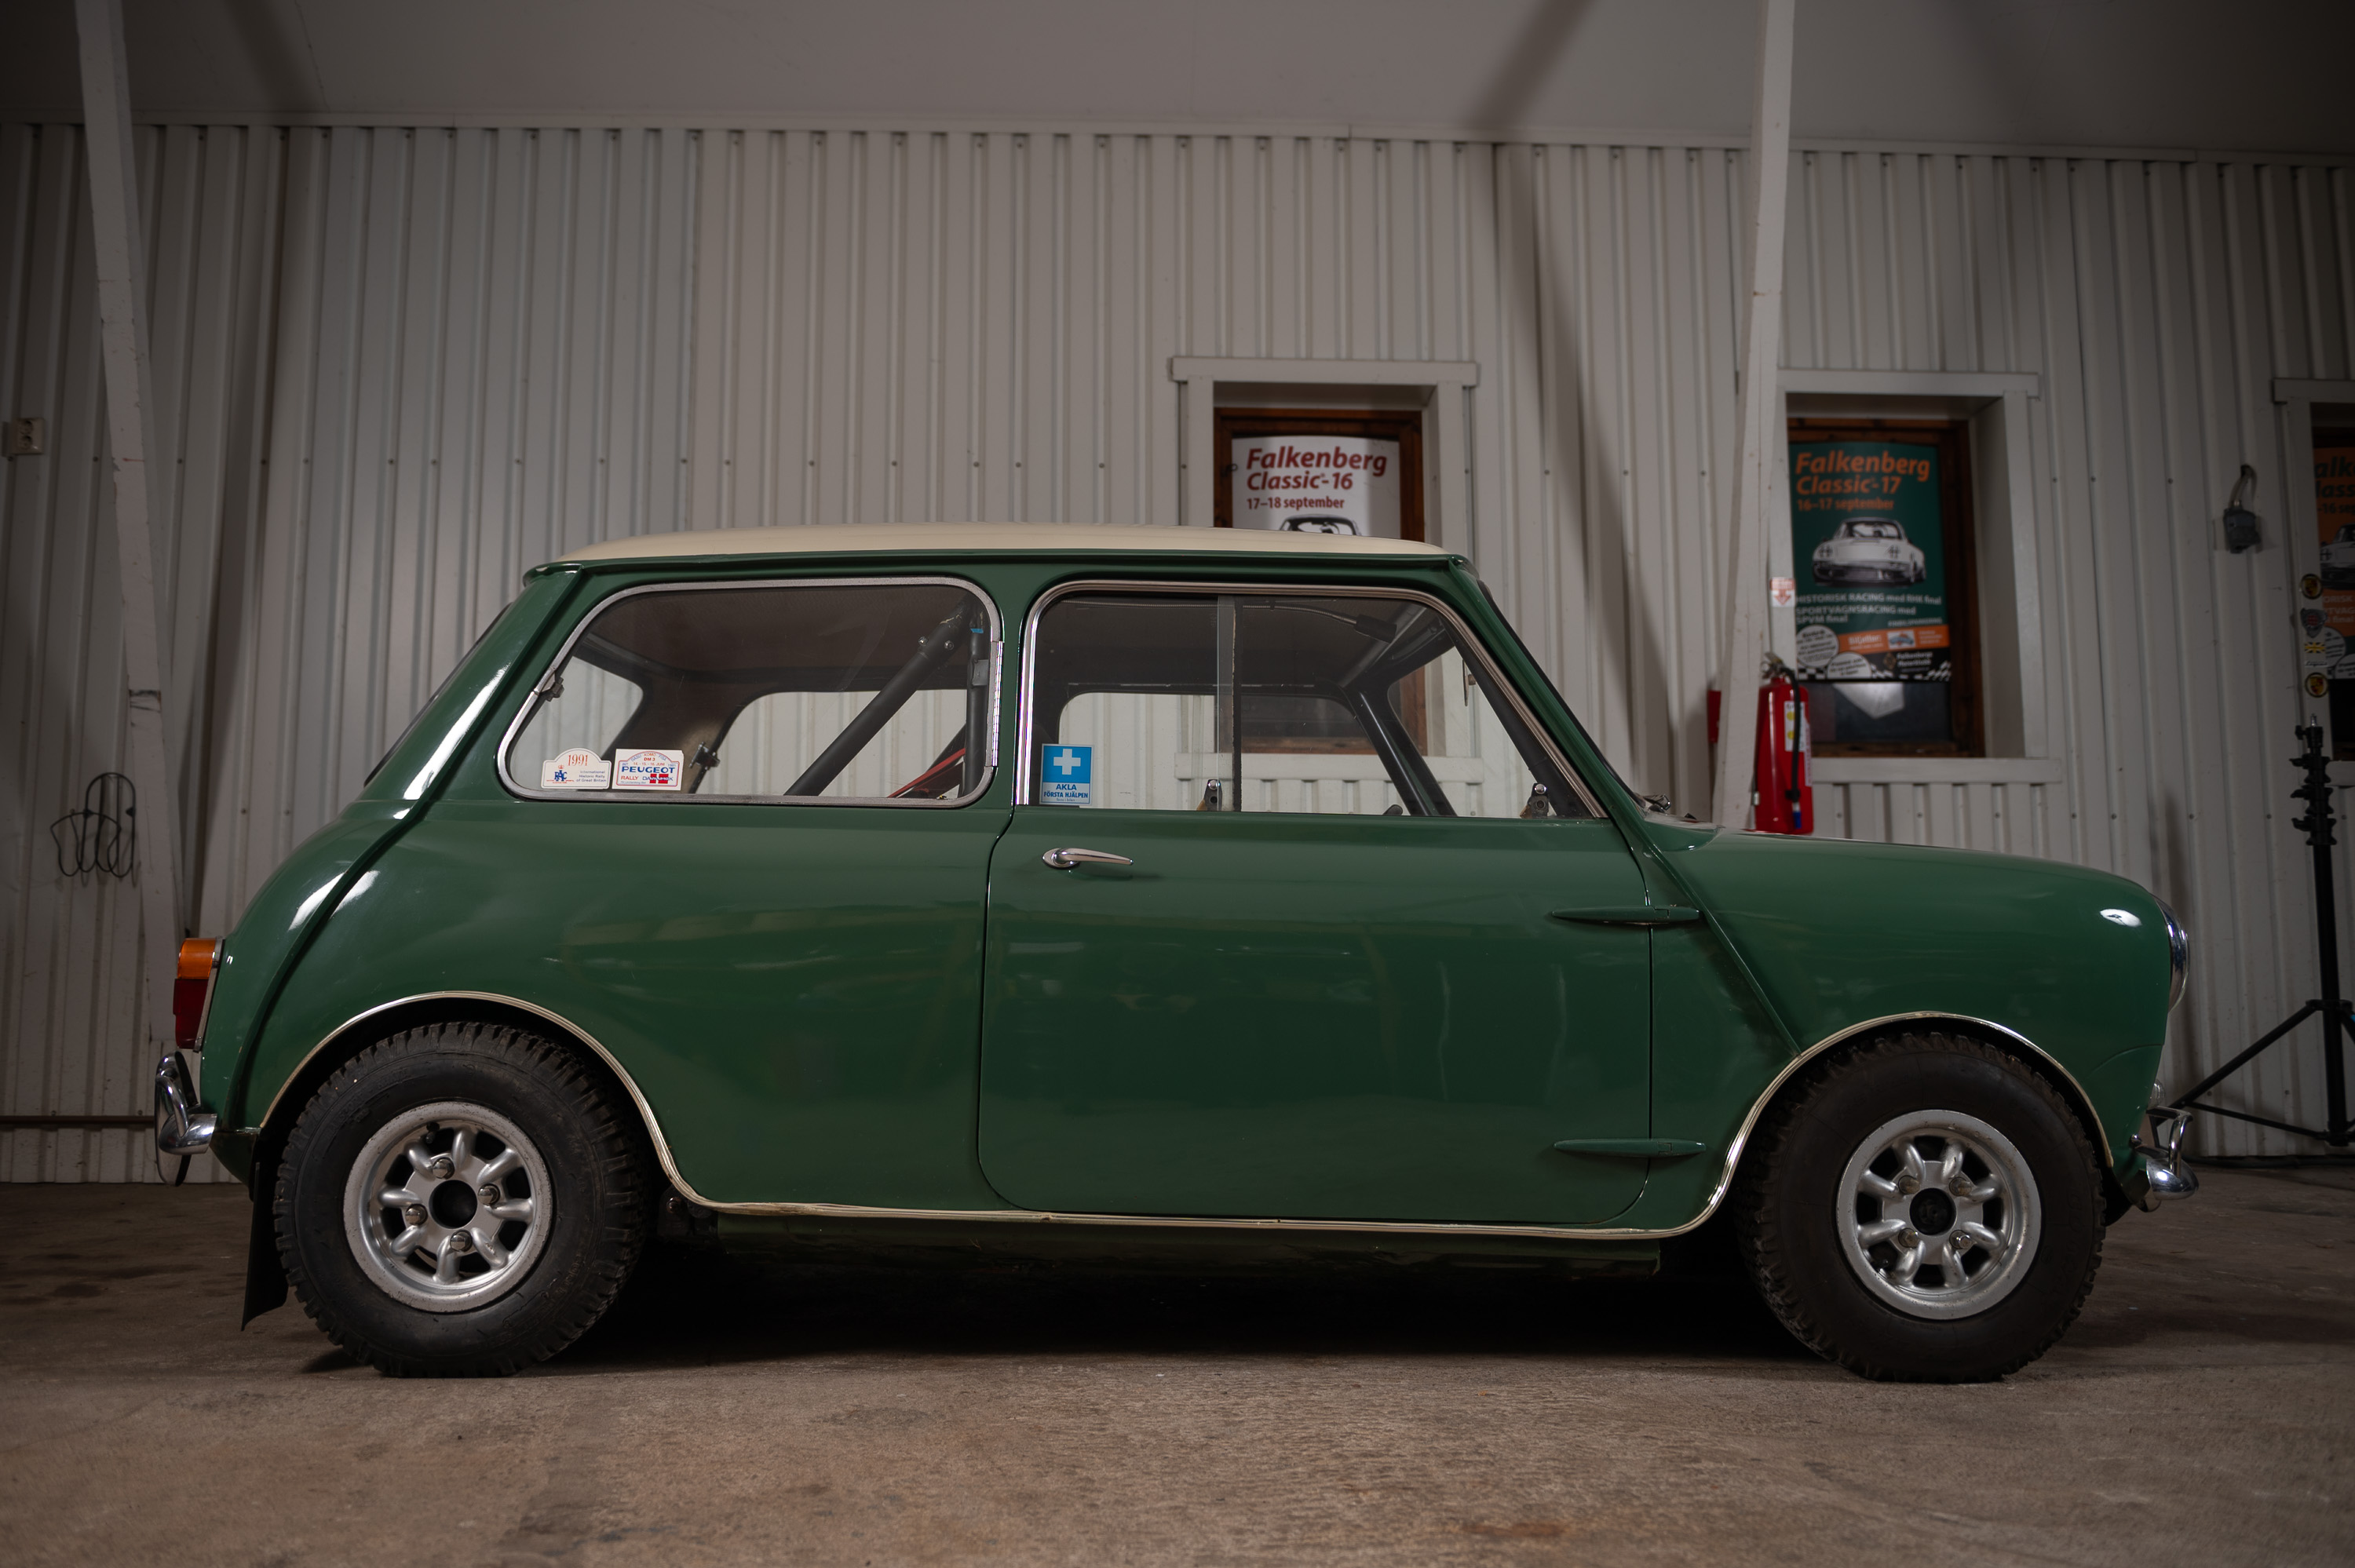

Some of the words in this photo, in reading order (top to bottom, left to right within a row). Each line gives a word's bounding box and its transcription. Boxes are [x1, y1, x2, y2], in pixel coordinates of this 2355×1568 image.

[1247, 446, 1387, 477] Falkenberg
[1795, 450, 1930, 482] Falkenberg
[2314, 456, 2355, 478] alk
[1283, 496, 1345, 511] september
[1835, 496, 1894, 512] september
[1848, 592, 1885, 603] RACING
[1886, 593, 1905, 603] med
[1924, 594, 1941, 605] final
[1897, 606, 1916, 615] med
[1826, 614, 1848, 624] final
[568, 754, 588, 766] 1991
[554, 769, 568, 782] RAC
